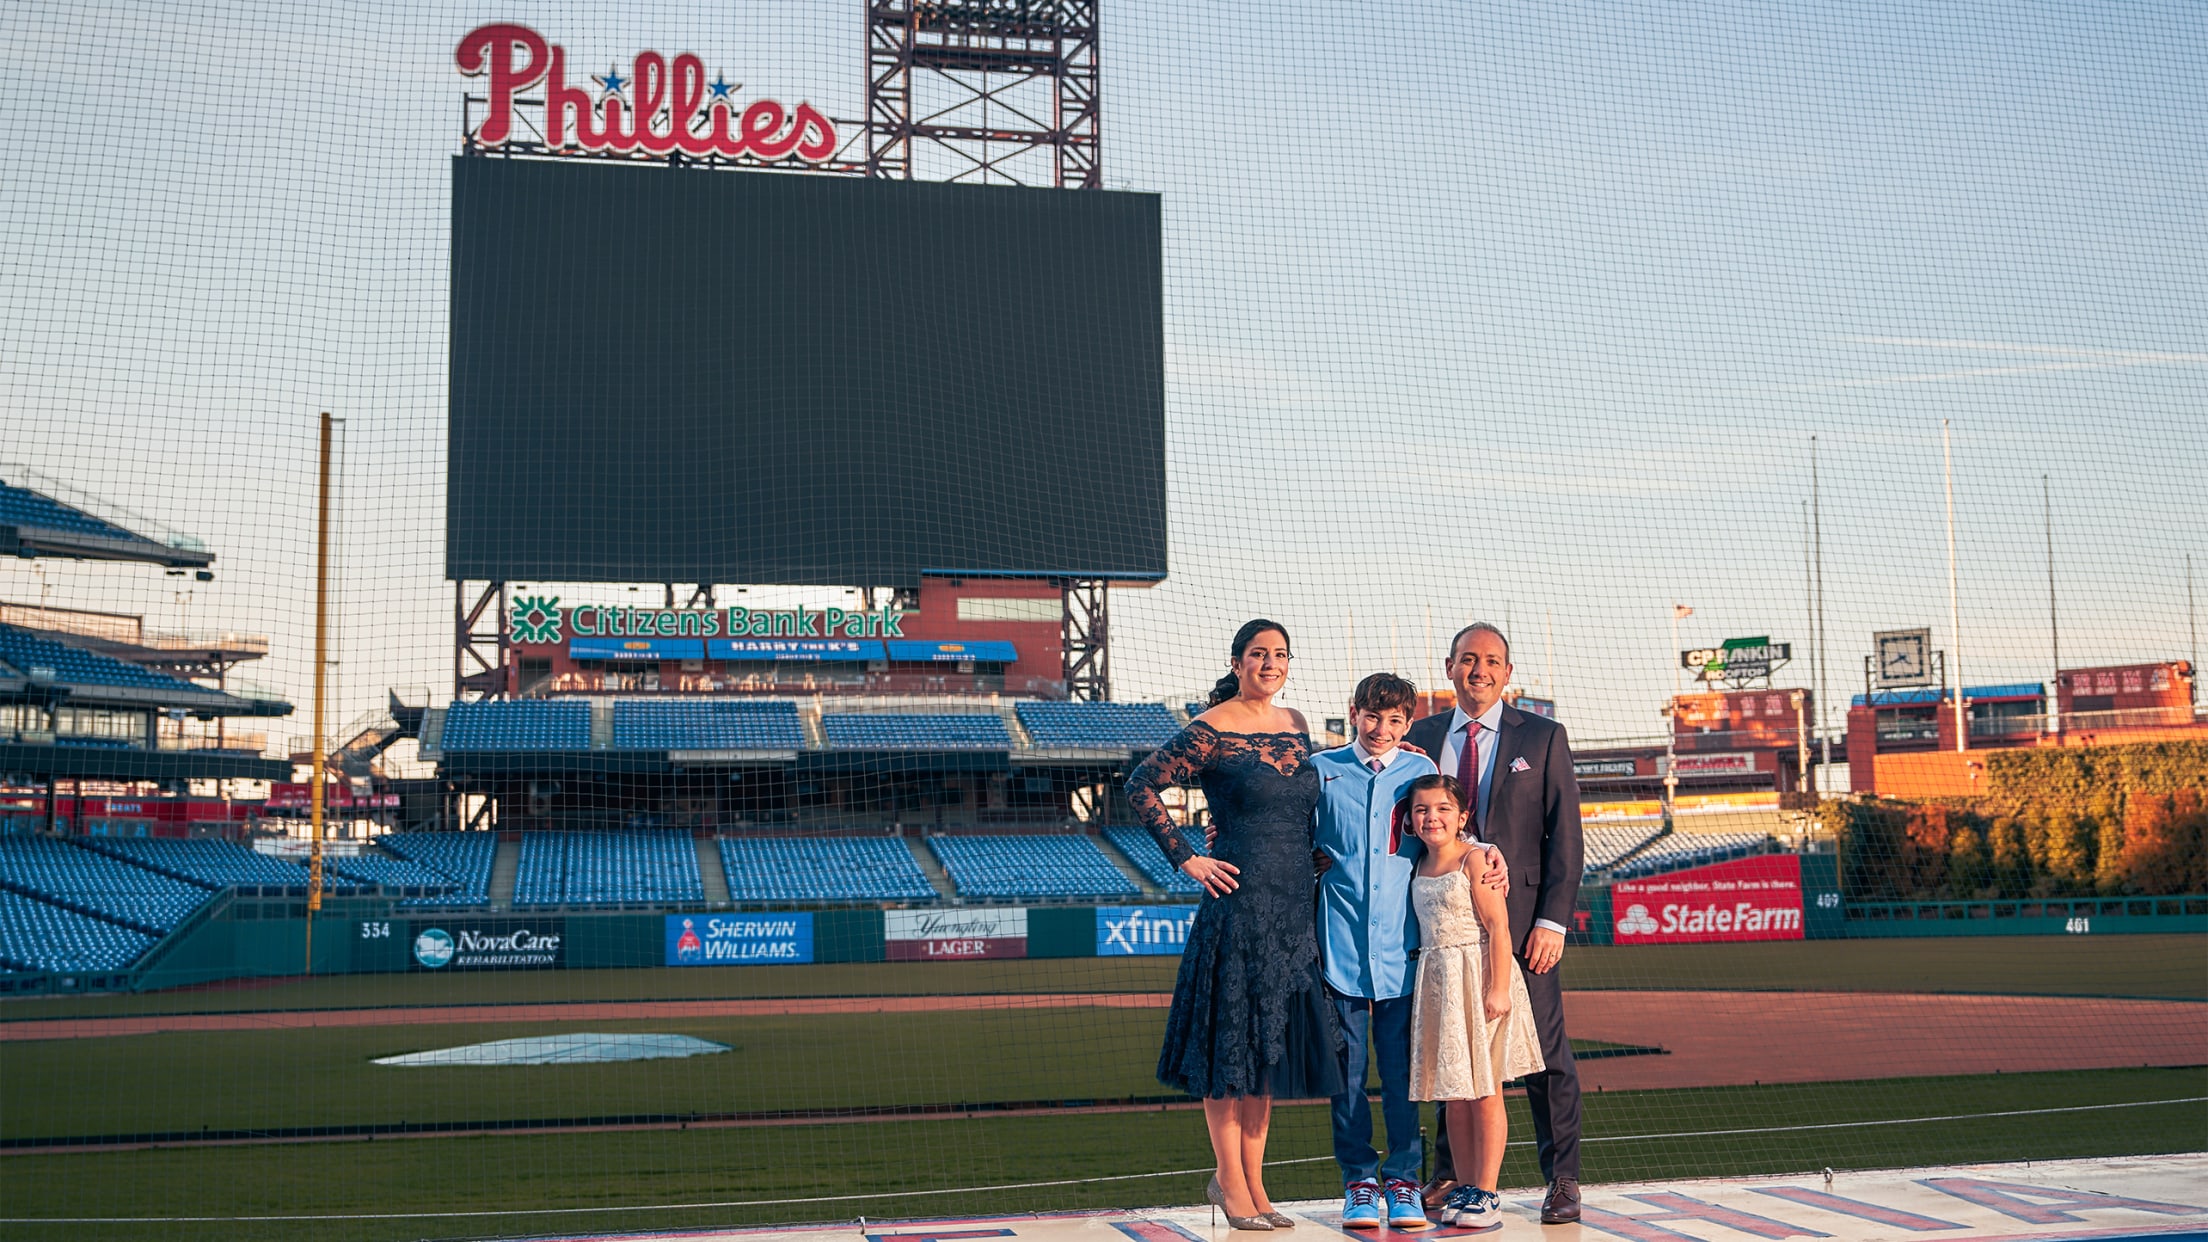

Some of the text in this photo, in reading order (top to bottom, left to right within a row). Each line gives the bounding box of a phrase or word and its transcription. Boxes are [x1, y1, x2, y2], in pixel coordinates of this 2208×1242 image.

[456, 22, 838, 162] Phillies
[570, 605, 905, 639] Citizens Bank Park
[731, 641, 800, 651] HARRY
[1617, 884, 1637, 893] Like
[1647, 883, 1669, 894] good
[1712, 881, 1736, 891] State
[1737, 880, 1761, 890] Farm
[1816, 893, 1840, 909] 409
[361, 922, 391, 938] 334
[706, 918, 797, 939] SHERWIN
[912, 914, 1000, 938] Yuengling
[456, 929, 561, 951] NovaCare
[928, 940, 986, 955] LAGER
[456, 954, 556, 966] REHABILITATION
